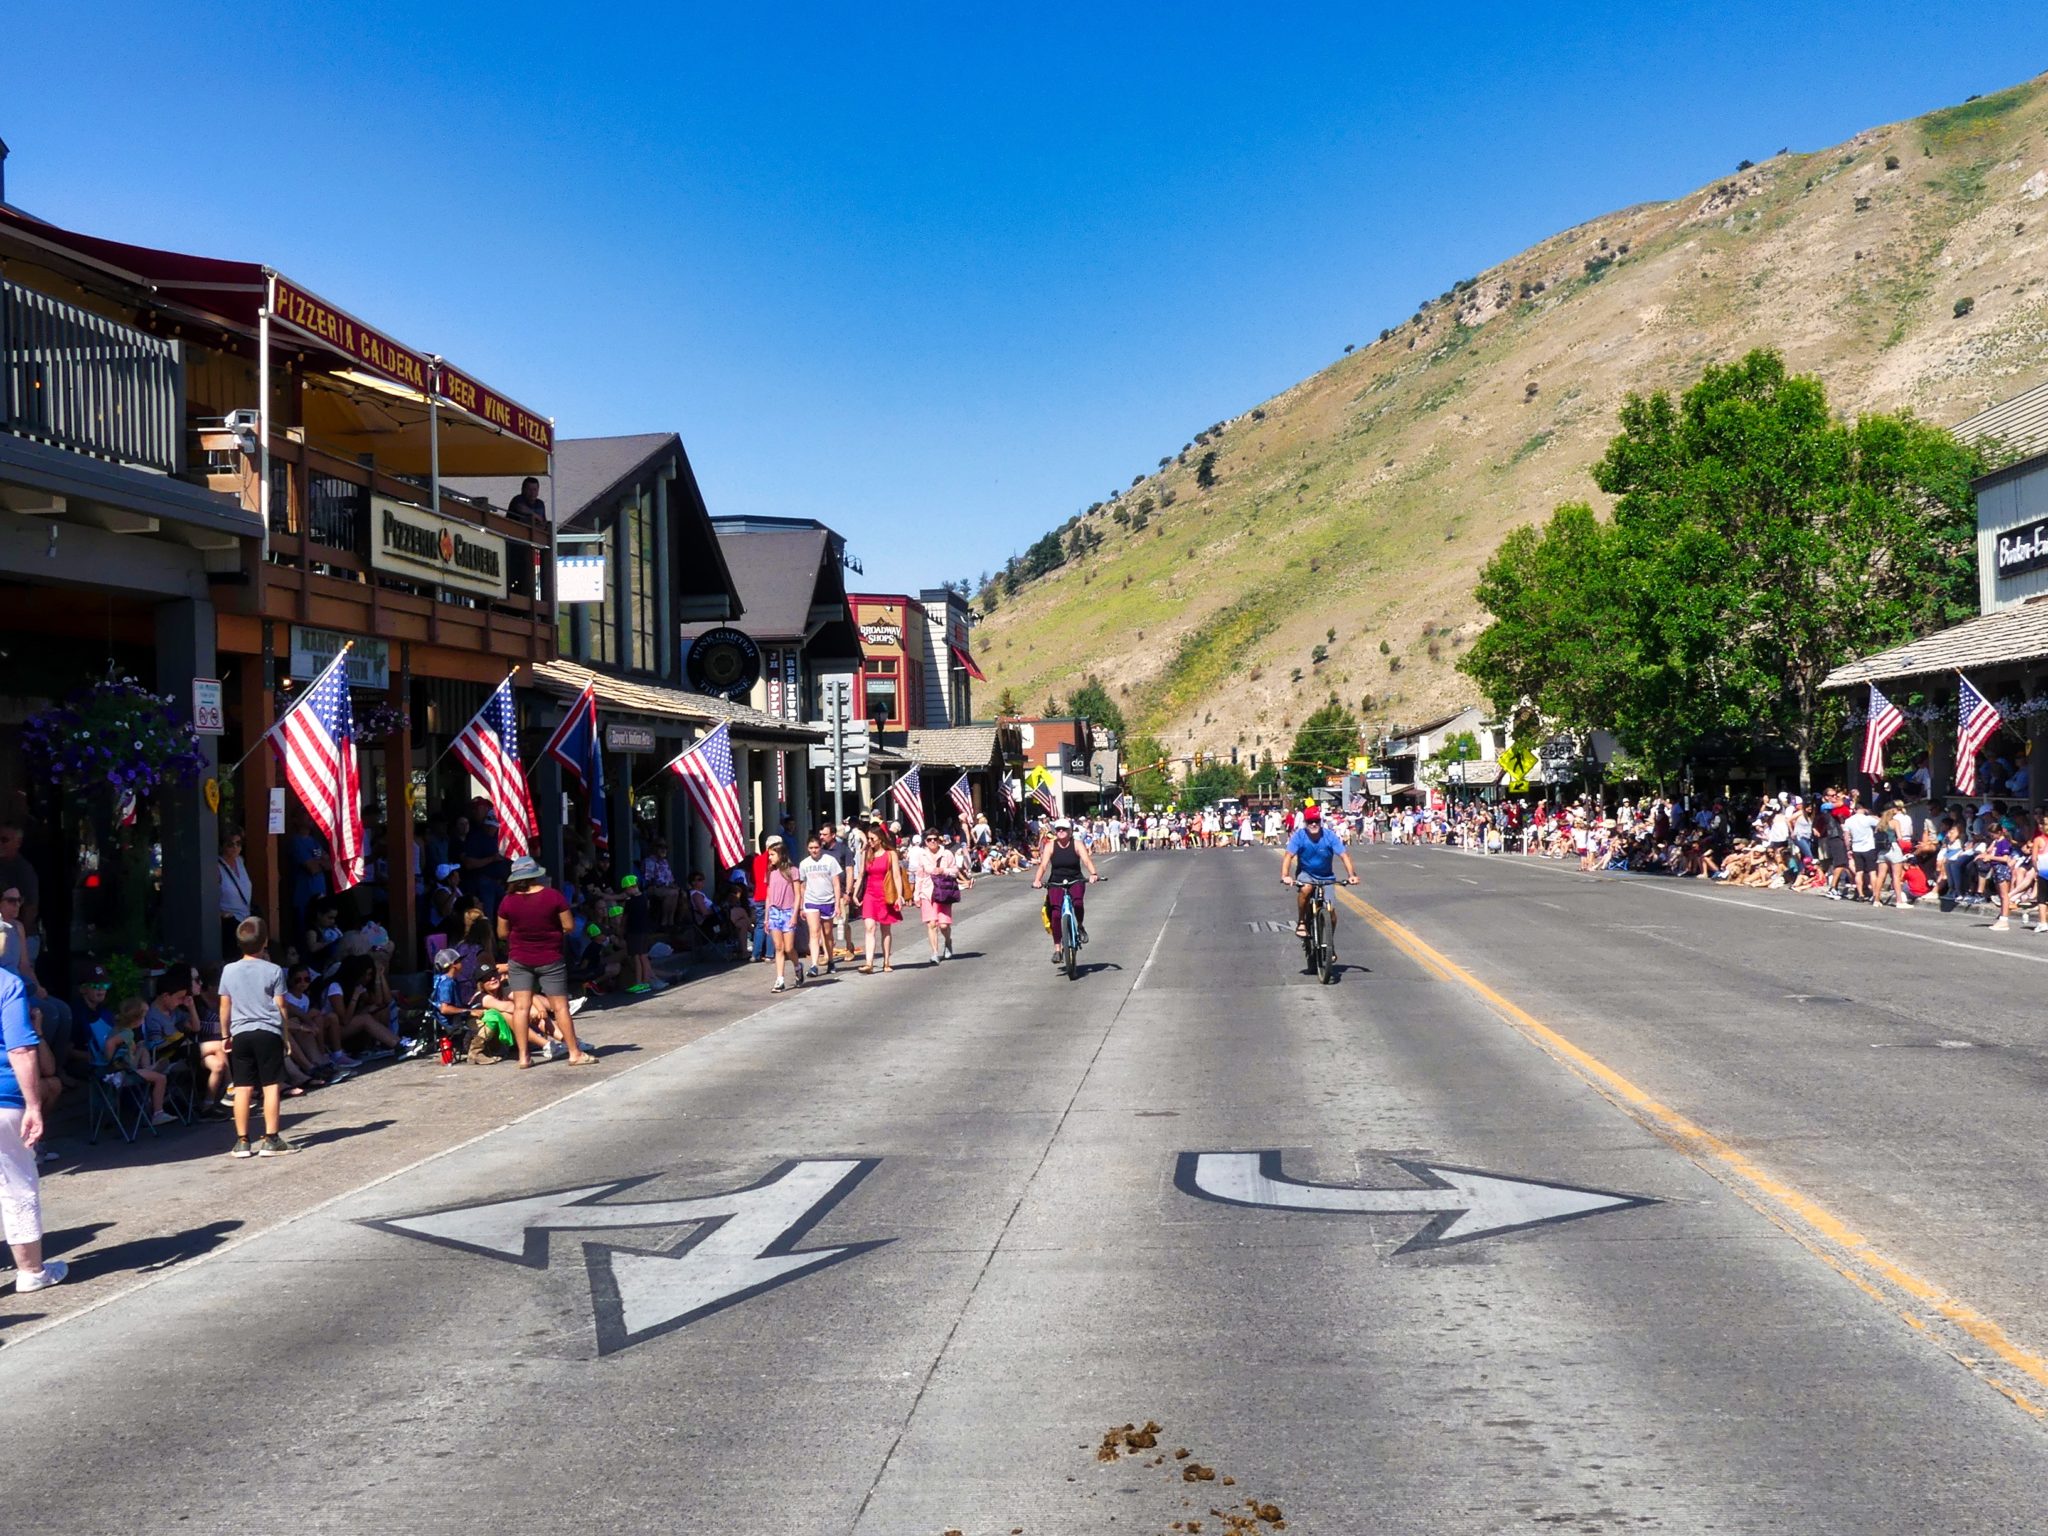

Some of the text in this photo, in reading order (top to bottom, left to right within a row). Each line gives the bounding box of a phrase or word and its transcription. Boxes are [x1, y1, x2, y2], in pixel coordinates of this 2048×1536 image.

[277, 286, 425, 387] PIZZERIA CALDERA
[448, 373, 549, 445] BEER WINE PIZZA
[693, 631, 755, 659] PINK GARTER
[860, 625, 902, 640] BROADWAY
[868, 633, 895, 644] SHOPS
[343, 637, 379, 660] OOSE
